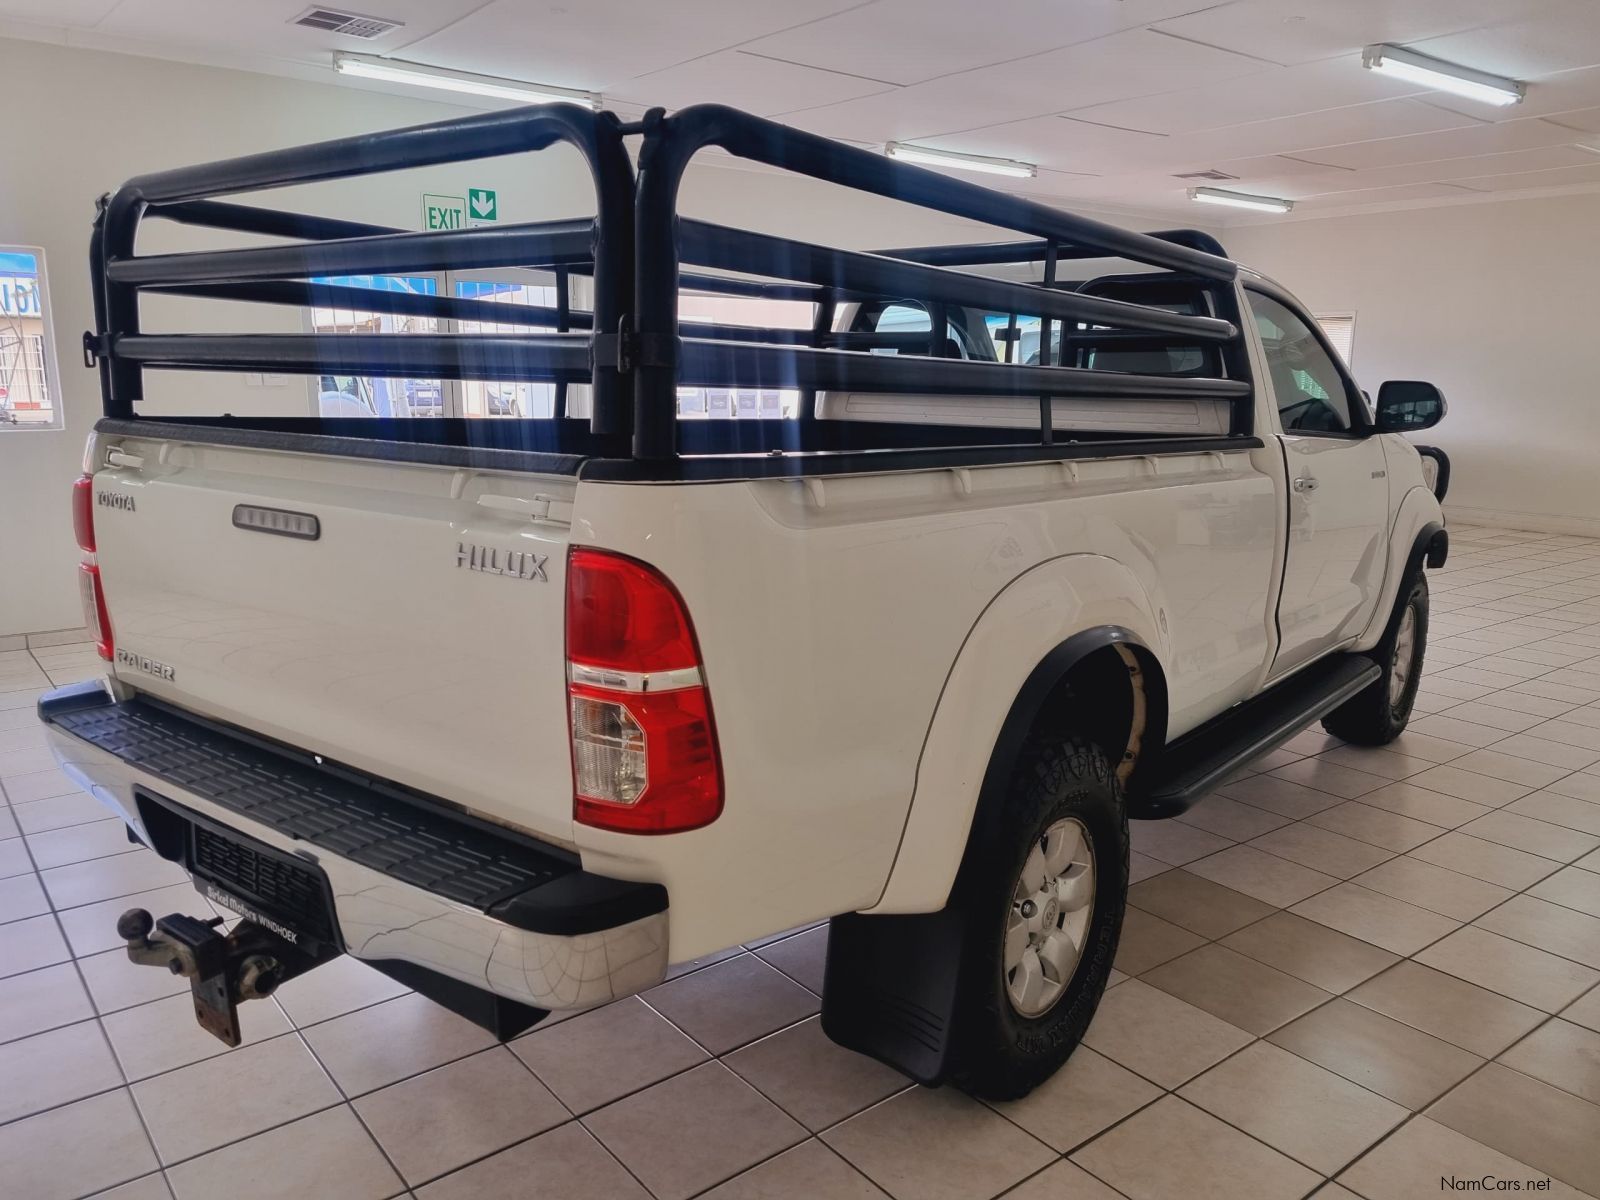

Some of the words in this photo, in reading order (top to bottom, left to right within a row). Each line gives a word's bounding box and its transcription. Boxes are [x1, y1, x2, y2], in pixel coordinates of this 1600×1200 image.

[428, 206, 461, 230] EXIT
[96, 490, 136, 512] TOYOTA
[456, 542, 549, 583] HILUX
[116, 647, 175, 682] RAIDER
[229, 898, 257, 922] Motors
[258, 914, 297, 944] WINDHOEK
